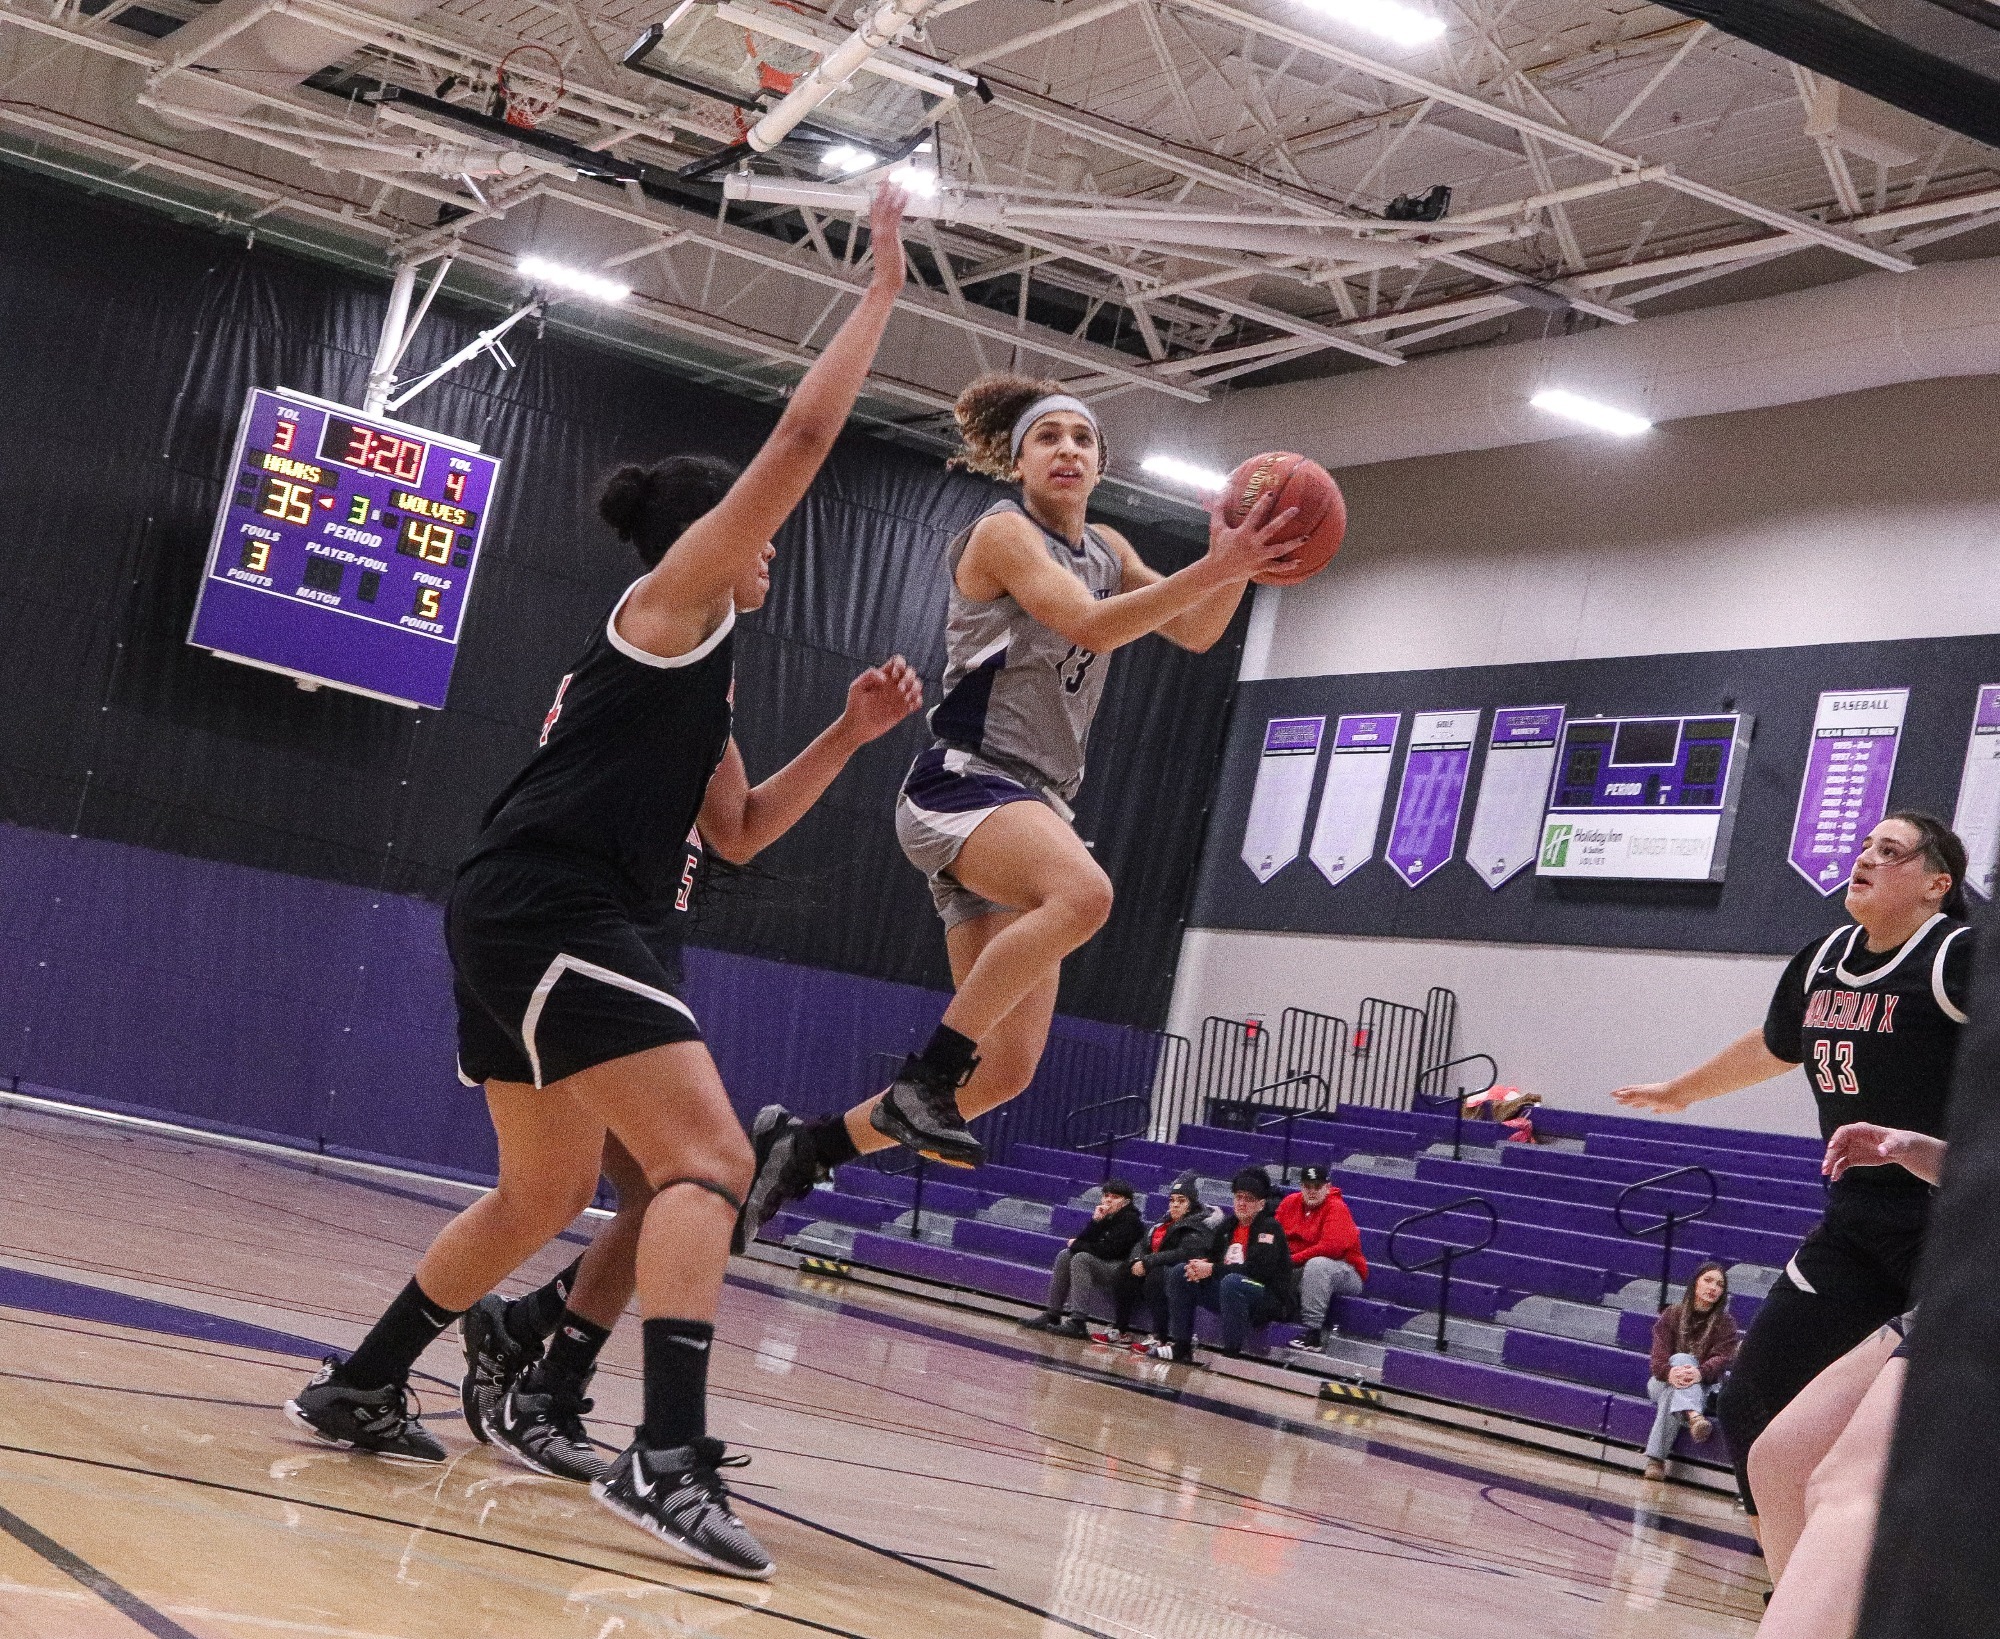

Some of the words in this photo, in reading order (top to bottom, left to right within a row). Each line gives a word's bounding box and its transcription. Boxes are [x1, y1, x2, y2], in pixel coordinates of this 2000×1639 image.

[277, 406, 300, 422] TOL
[272, 421, 297, 453] 3
[262, 453, 322, 484] HAWKS
[344, 426, 425, 481] 3:20
[449, 457, 472, 473] TOL
[262, 478, 314, 526] 35
[446, 472, 467, 503] 4
[347, 494, 370, 526] 3
[398, 493, 467, 525] WOLVES
[240, 524, 282, 542] FOULS
[323, 522, 382, 548] PERIOD
[407, 521, 454, 566] 43
[246, 541, 272, 572] 3
[227, 568, 273, 587] POINTS
[412, 571, 452, 590] FOULS
[296, 587, 342, 605] MATCH
[419, 589, 440, 619] 5
[400, 616, 444, 634] POINTS
[1832, 700, 1889, 711] BASEBALL
[1604, 783, 1642, 796] PERIOD
[1573, 828, 1606, 846] Holiday
[1606, 828, 1623, 842] Inn
[1803, 990, 1878, 1032] MALCOLM
[1878, 995, 1900, 1033] X
[1814, 1040, 1859, 1095] 33
